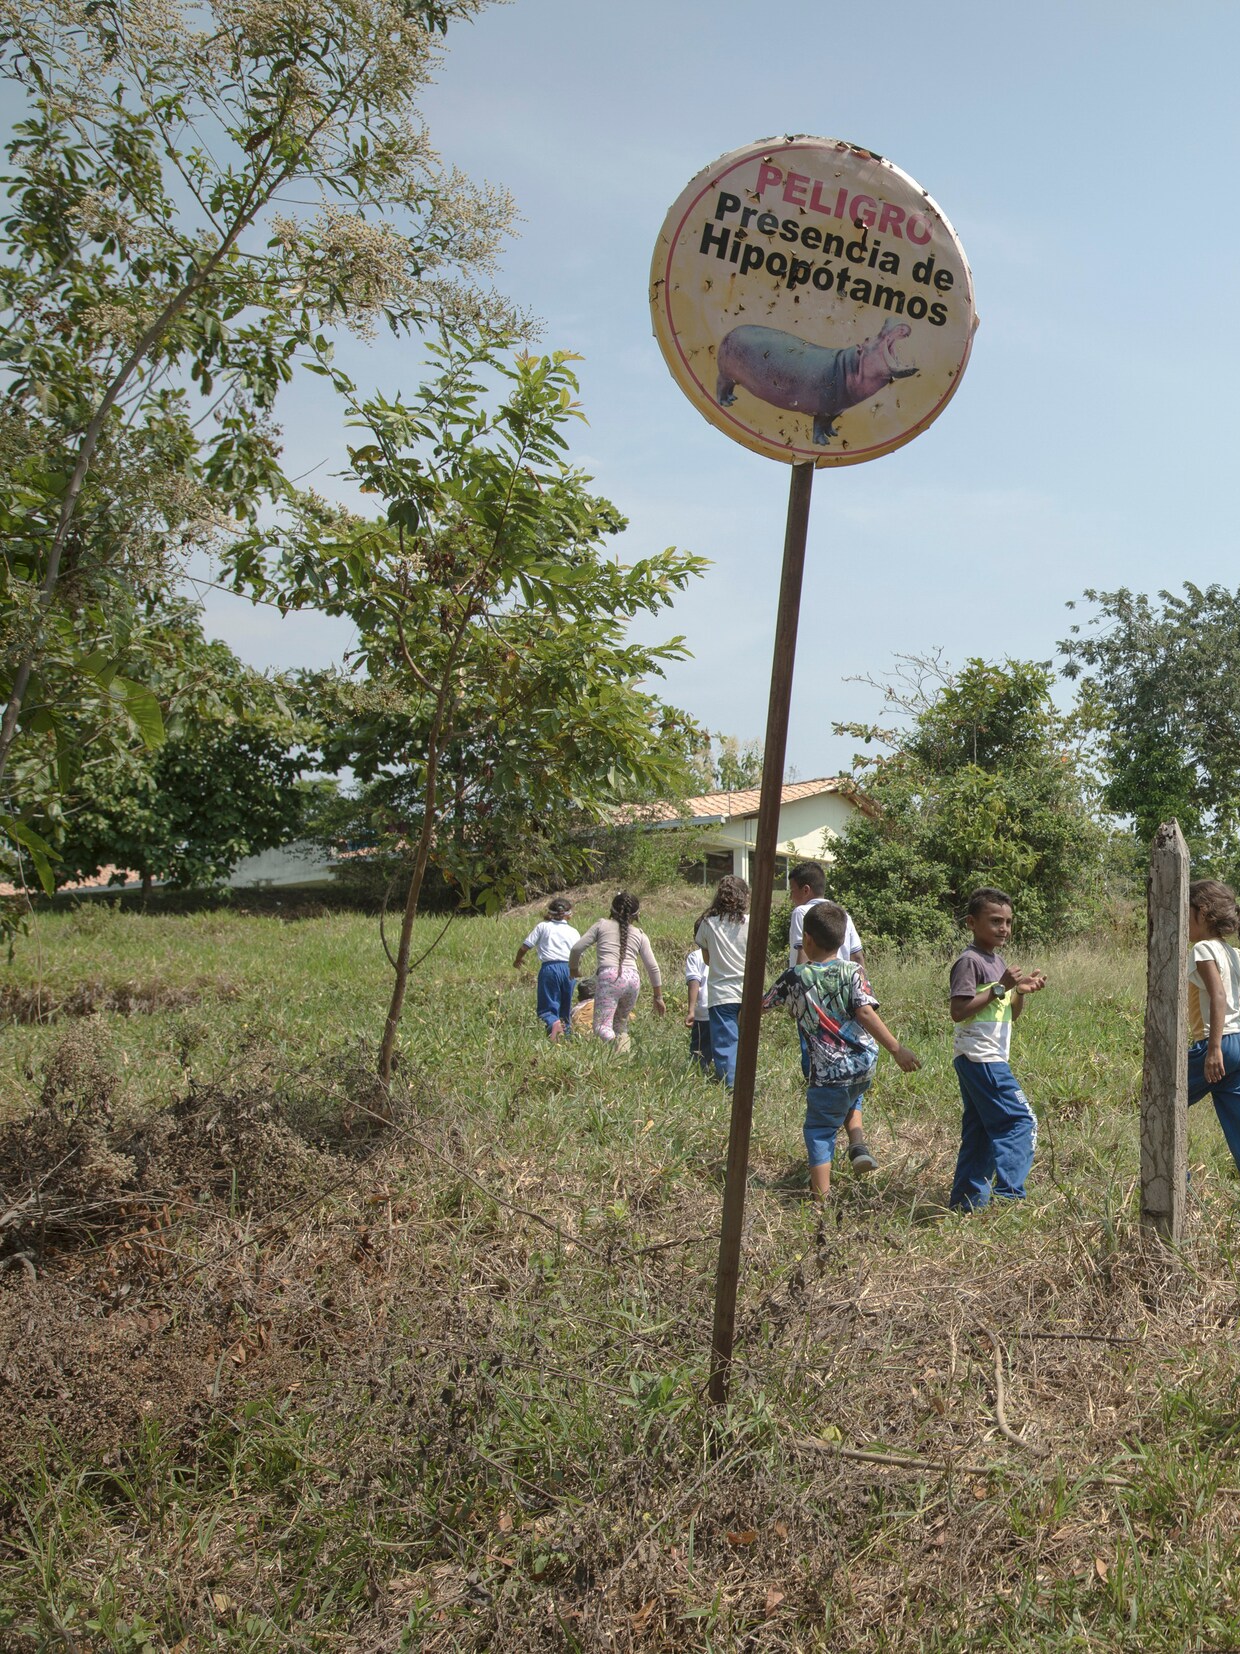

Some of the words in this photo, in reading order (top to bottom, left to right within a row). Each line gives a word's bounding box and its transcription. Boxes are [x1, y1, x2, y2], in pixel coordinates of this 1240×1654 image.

[714, 191, 901, 276] Presencia
[912, 256, 955, 292] de
[755, 163, 933, 246] PELIGRO
[699, 222, 949, 327] Hipopótamos
